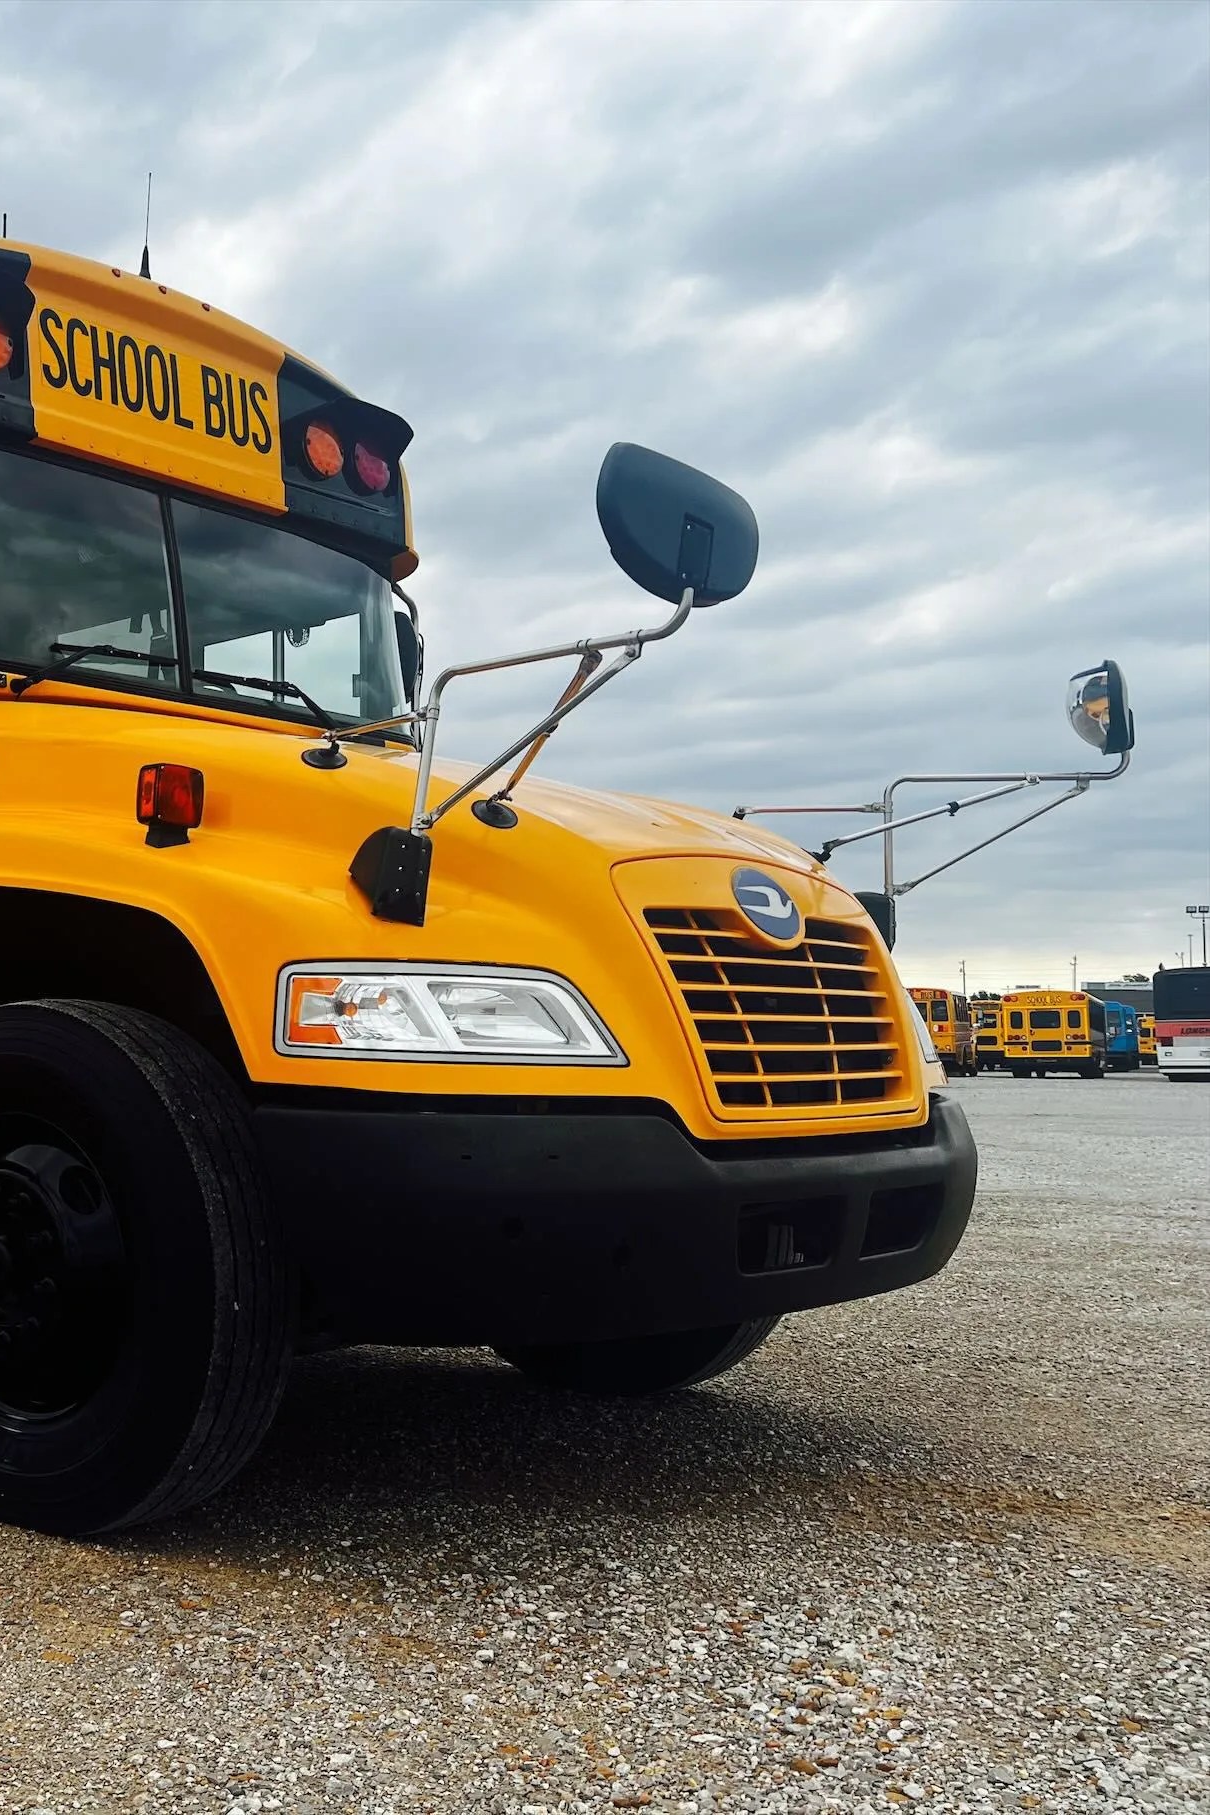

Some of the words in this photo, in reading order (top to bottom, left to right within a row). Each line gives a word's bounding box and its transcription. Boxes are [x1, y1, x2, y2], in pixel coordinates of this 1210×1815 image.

[39, 308, 194, 430] SCHOOL
[200, 364, 272, 454] BUS
[920, 991, 934, 1000] BUS
